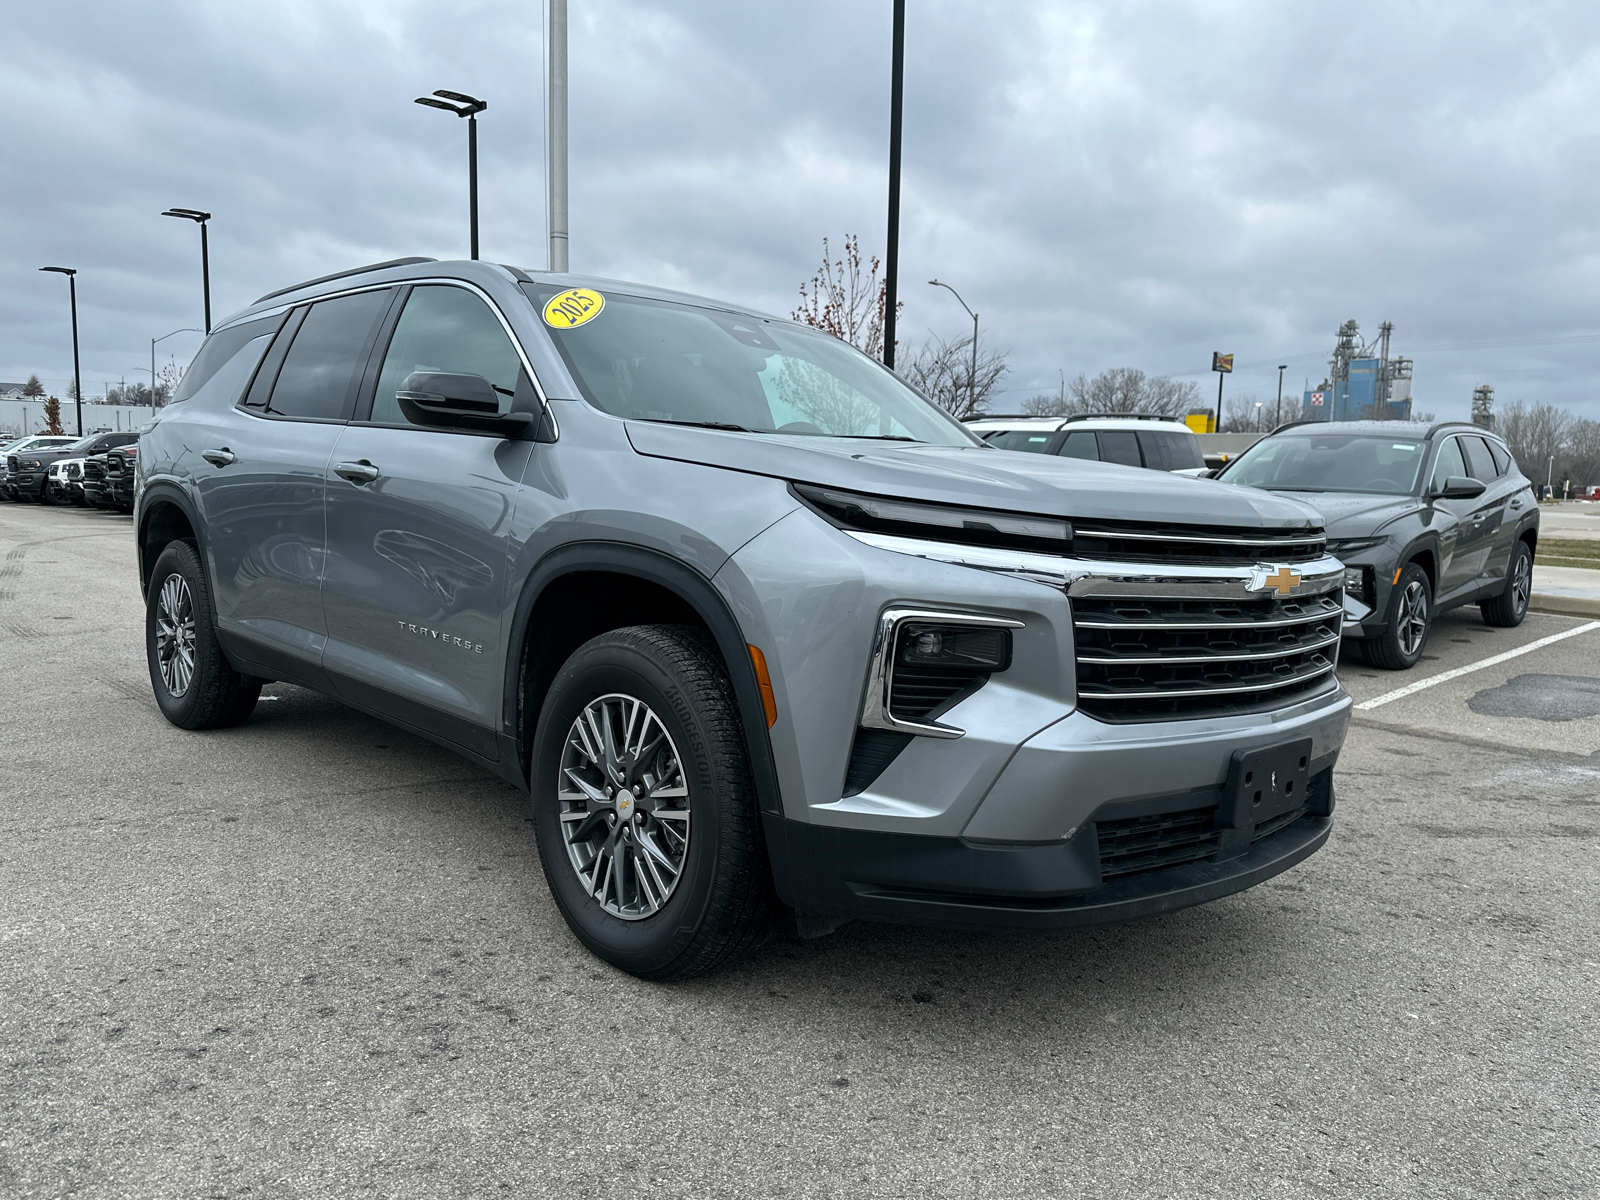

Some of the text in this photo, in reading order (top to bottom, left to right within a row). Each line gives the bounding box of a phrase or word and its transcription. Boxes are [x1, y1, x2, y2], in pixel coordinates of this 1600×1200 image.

[551, 291, 595, 325] 2025
[398, 620, 484, 654] TRAVERSE
[664, 684, 714, 796] BRIDGESTONE
[647, 935, 686, 967] ALENZ
